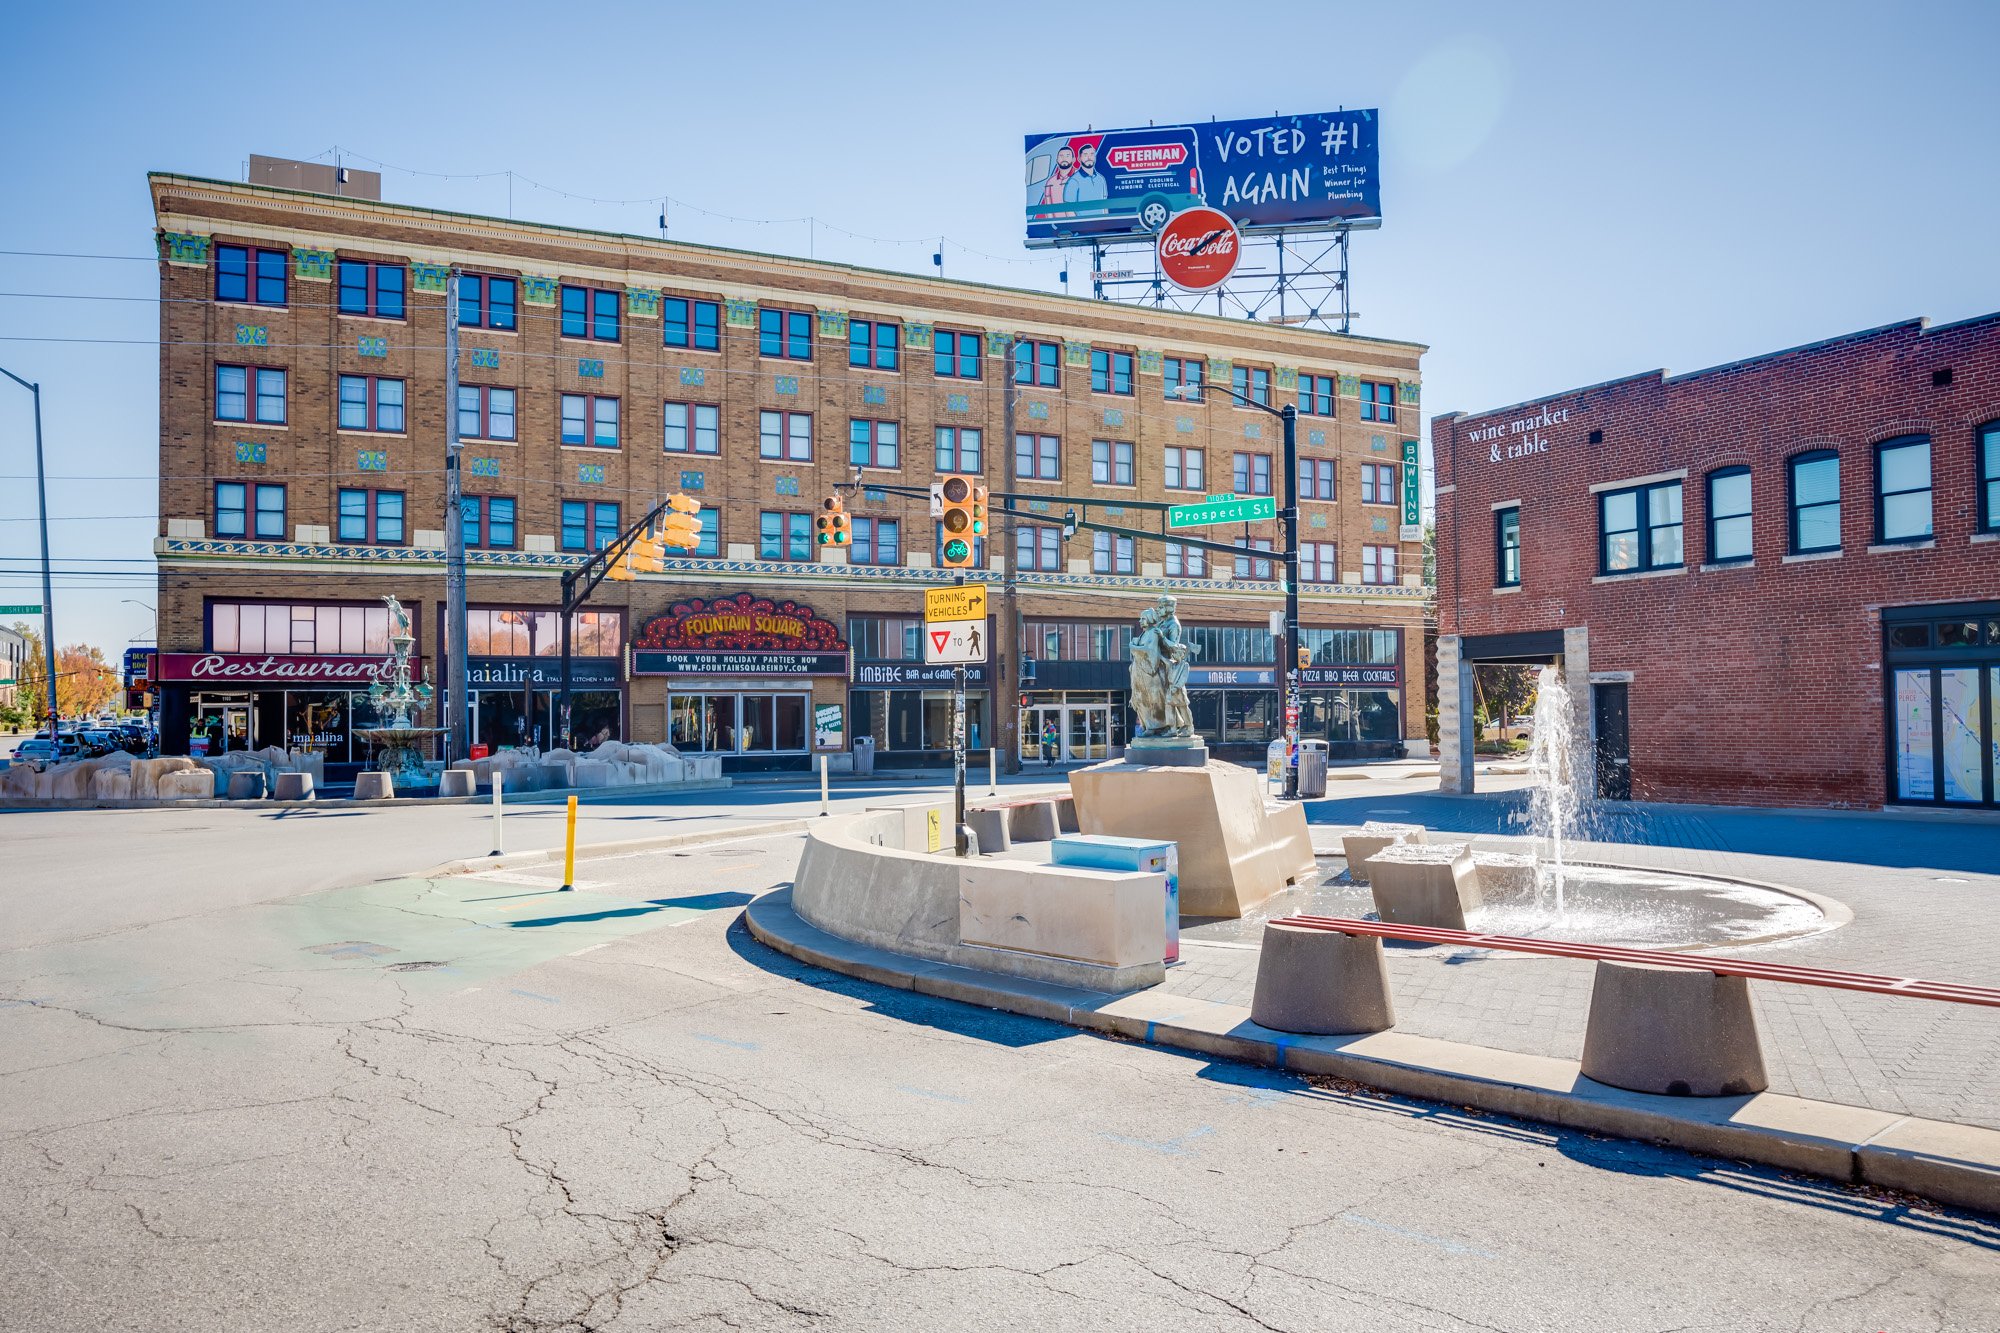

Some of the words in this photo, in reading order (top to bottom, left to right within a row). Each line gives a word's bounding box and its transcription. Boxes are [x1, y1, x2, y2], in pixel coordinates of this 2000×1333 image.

[1215, 127, 1306, 163] VOTED
[1321, 121, 1359, 155] #1
[1114, 148, 1180, 163] PETERMAN
[1323, 166, 1338, 175] Best
[1341, 164, 1367, 174] Things
[1222, 167, 1310, 207] AGAIN
[1324, 179, 1350, 188] Winner
[1353, 178, 1366, 188] for
[1327, 191, 1363, 201] Plumbing
[1090, 271, 1132, 280] FOXPOINT
[1469, 423, 1506, 443] wine
[1511, 405, 1569, 434] market
[1490, 443, 1503, 463] &
[1507, 432, 1548, 459] table
[1406, 446, 1417, 521] BOWLING
[1174, 505, 1243, 522] Prospect
[1253, 503, 1270, 515] St
[929, 592, 966, 604] TURNING
[928, 606, 968, 617] VEHICLES
[685, 615, 750, 636] FOUNTAIN
[754, 616, 804, 638] SQUARE
[953, 637, 963, 647] TO
[666, 655, 688, 663] BOOK
[695, 655, 717, 663] YOUR
[723, 655, 757, 664] HOLIDAY
[763, 656, 796, 664] PARTIES
[191, 656, 396, 679] Restaurant
[678, 664, 808, 672] WWW.FOUNTAINSQUAREINDY.COM
[906, 669, 919, 680] BAR
[921, 671, 934, 680] and
[935, 669, 957, 680] GAME
[1302, 670, 1321, 682] PIZZA
[1324, 670, 1339, 682] BBQ
[1342, 670, 1359, 682] BEER
[1362, 670, 1396, 682] COCKTAILS
